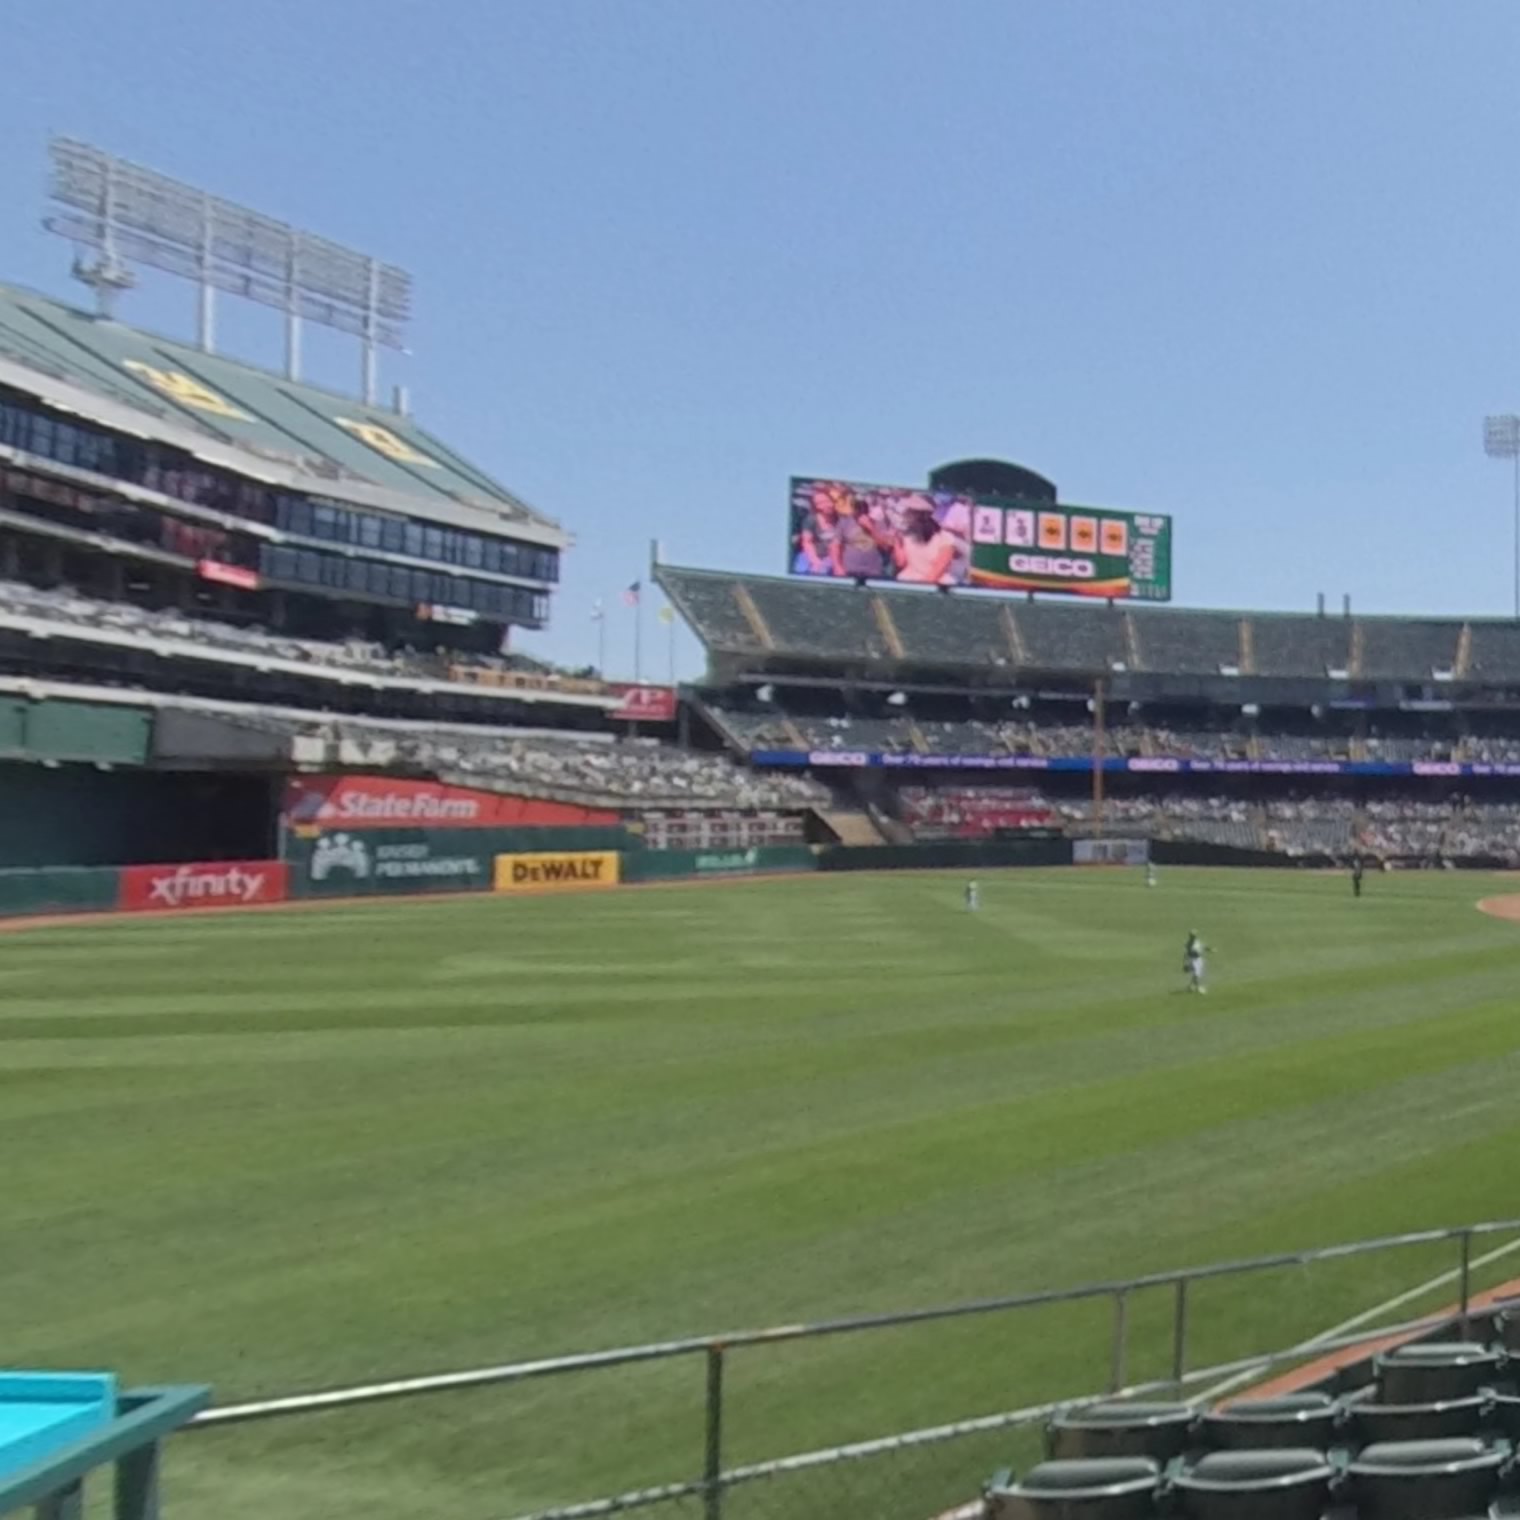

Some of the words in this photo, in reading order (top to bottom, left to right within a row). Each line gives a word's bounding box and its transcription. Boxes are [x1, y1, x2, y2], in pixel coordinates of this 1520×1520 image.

[1009, 553, 1096, 577] GEICO
[808, 752, 867, 766] GEICO
[1128, 758, 1179, 771] GEICO
[1413, 762, 1460, 775] GEICO
[149, 867, 264, 905] xfinity
